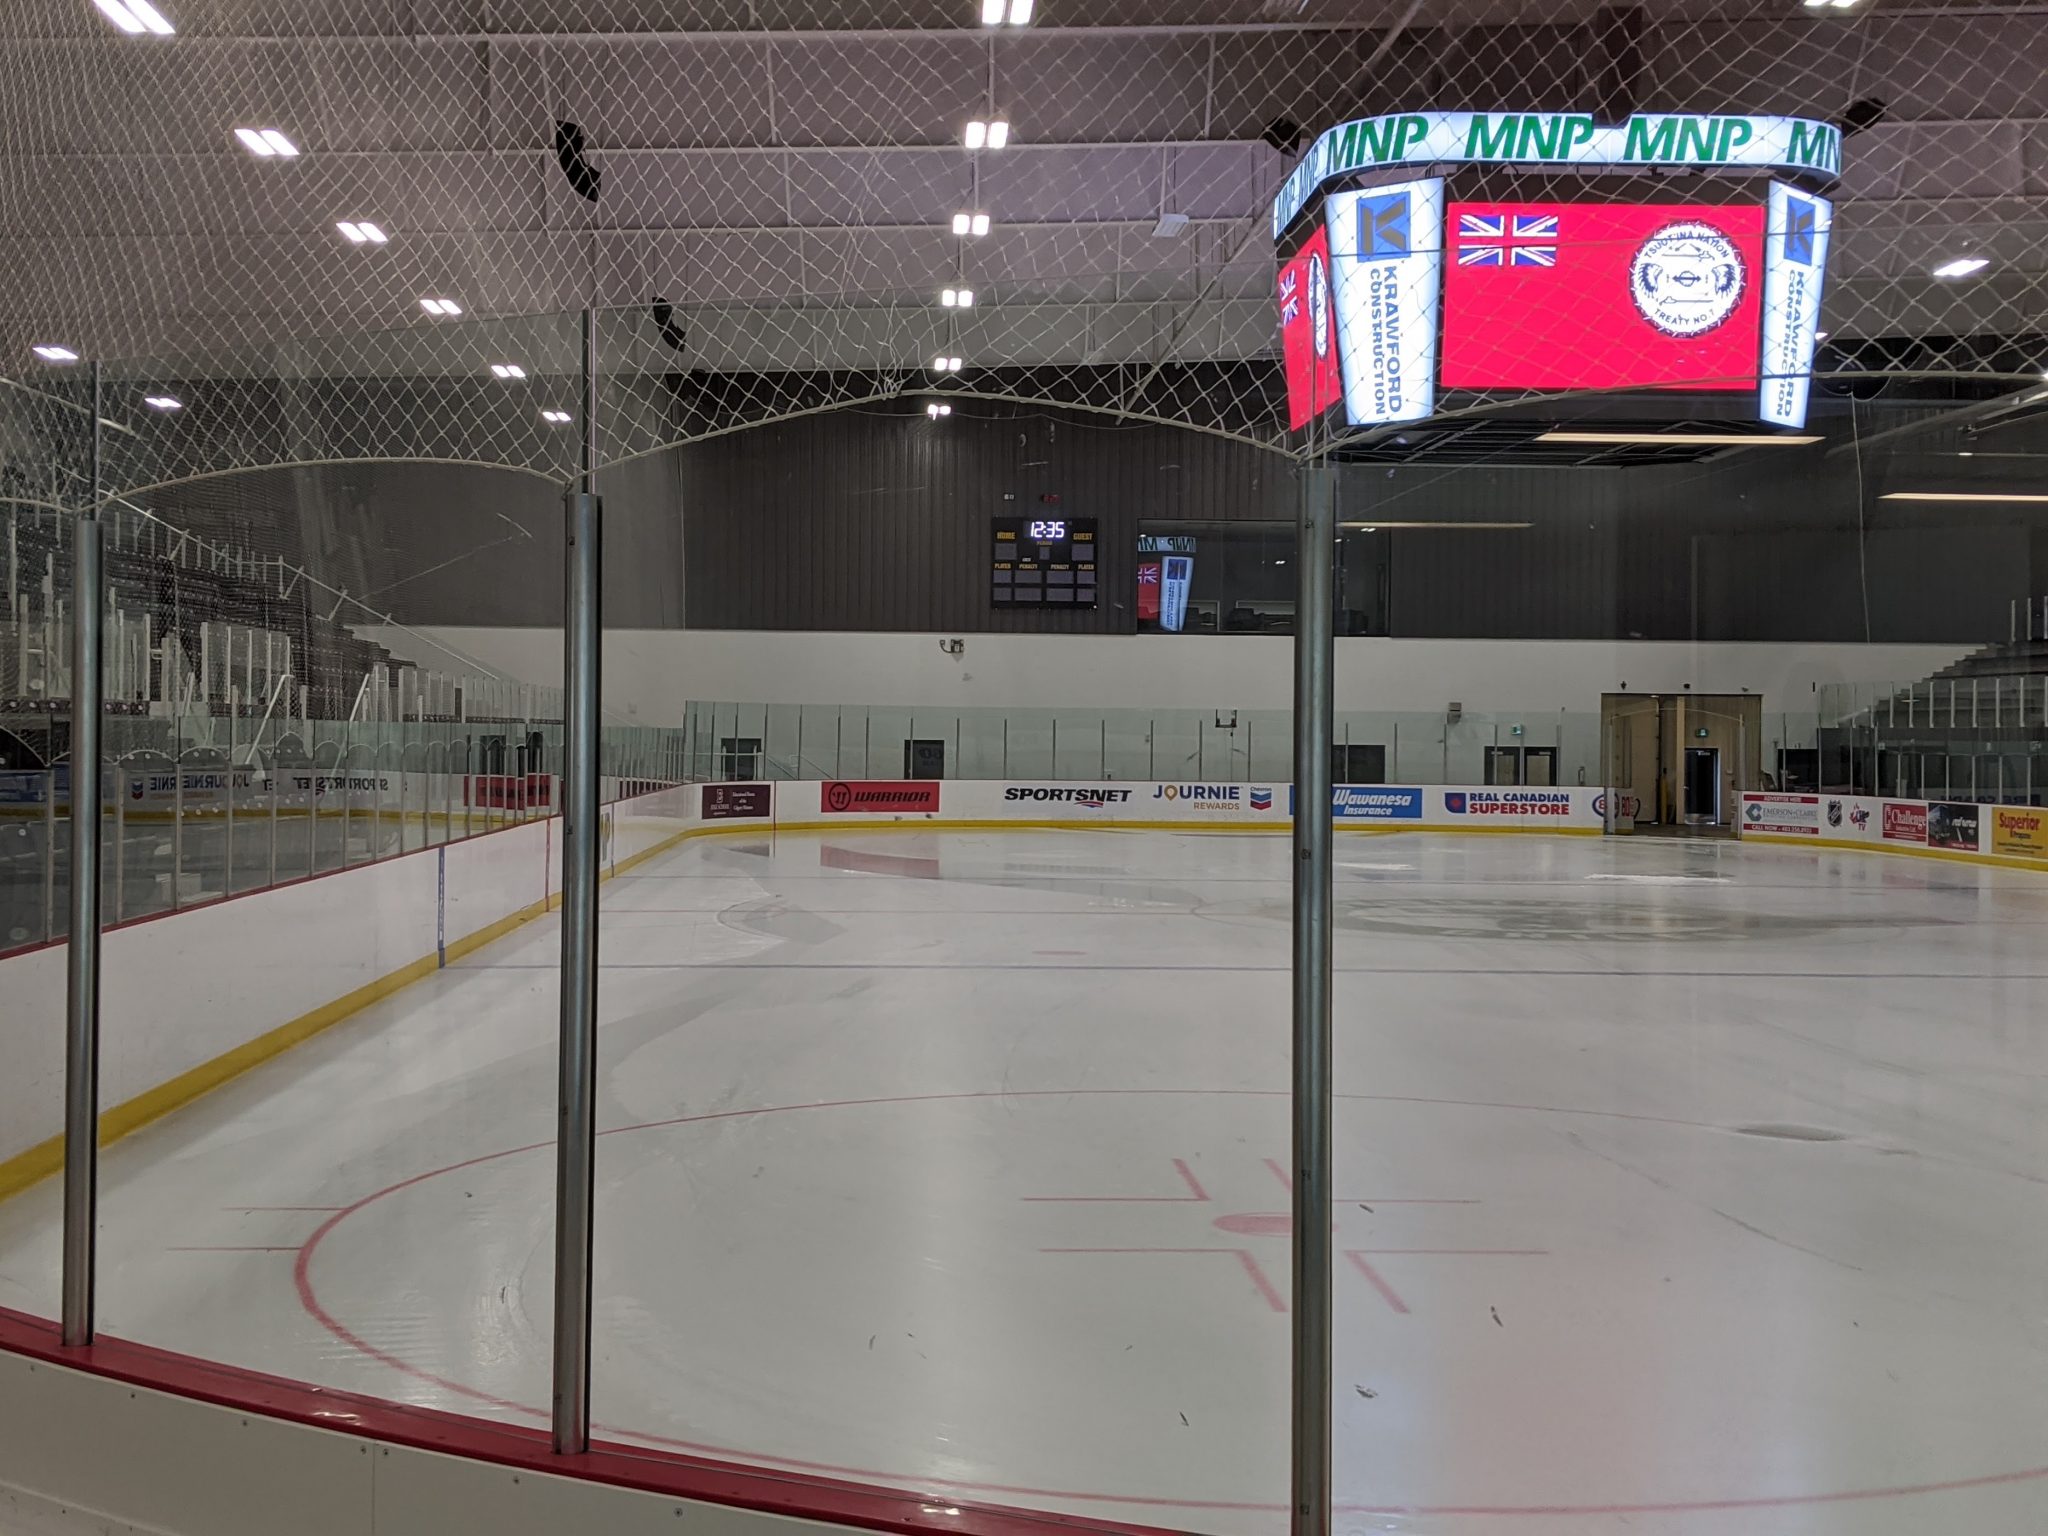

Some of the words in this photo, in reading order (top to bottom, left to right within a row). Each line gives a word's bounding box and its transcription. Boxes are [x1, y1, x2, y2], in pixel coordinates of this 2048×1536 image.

[1464, 114, 1594, 159] MNP
[1624, 118, 1752, 161] MNP
[1326, 115, 1429, 176] MNP
[1654, 308, 1690, 325] TREATY
[1370, 268, 1386, 415] CONSTRUCTION
[1384, 266, 1402, 413] KRAWFORD
[1776, 269, 1796, 416] CONSTRUCION
[1030, 521, 1065, 538] 12:35
[1073, 532, 1093, 541] GUEST
[854, 791, 931, 802] WARRIOR
[1004, 787, 1132, 802] SPORTSNET
[1153, 785, 1240, 801] JOURNIE
[1332, 789, 1412, 806] Wawanesa
[1470, 793, 1499, 802] REAL
[1503, 793, 1569, 803] CANADIAN
[1193, 802, 1240, 810] REWARDS
[1343, 805, 1393, 816] Insurance
[1470, 803, 1569, 815] SUPERSTORE
[1858, 823, 1866, 831] TV
[1891, 808, 1926, 829] Challenge
[1999, 812, 2040, 837] Superior
